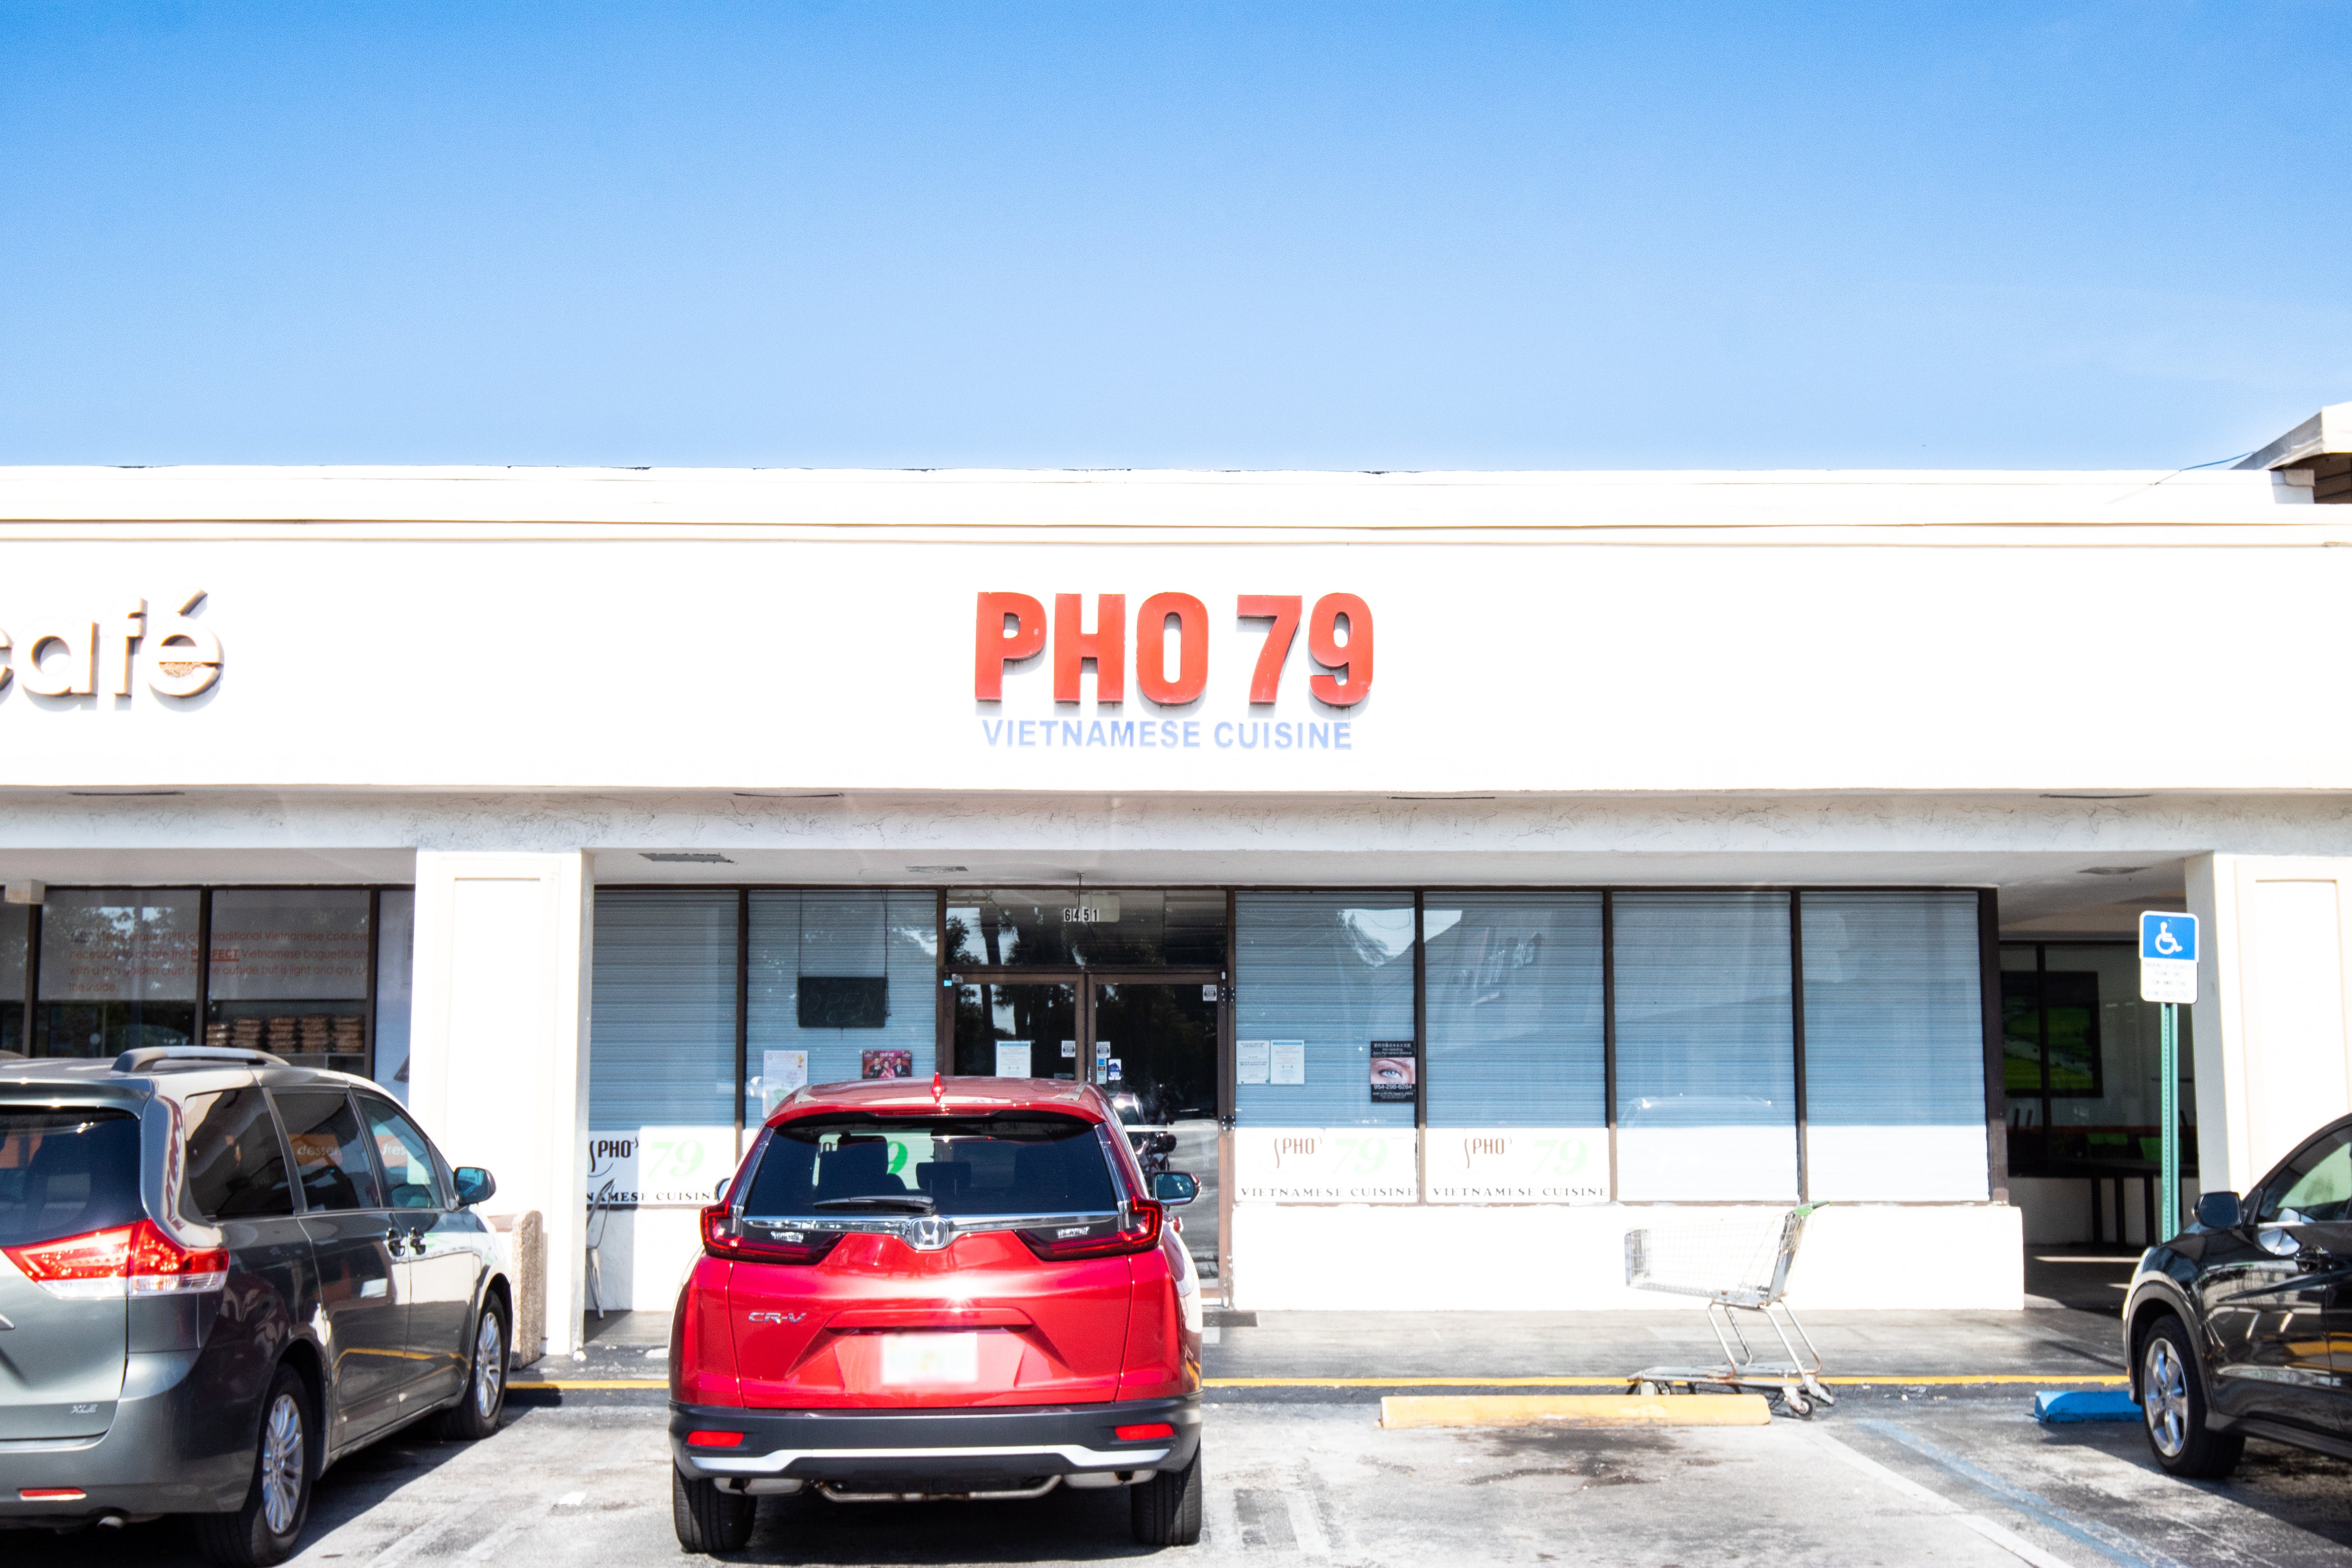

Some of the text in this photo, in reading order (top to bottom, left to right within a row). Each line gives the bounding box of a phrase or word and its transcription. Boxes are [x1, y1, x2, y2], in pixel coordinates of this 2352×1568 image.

[0, 587, 223, 698] afé
[975, 592, 1373, 705] PHO 79
[982, 720, 1352, 750] VIETNAMESE CUISINE
[1065, 909, 1097, 921] 6451
[265, 931, 323, 941] Vietnamese
[241, 949, 301, 959] Vietnamese
[647, 1139, 705, 1179] 79
[1241, 1187, 1416, 1197] VIETNAMESE CUISINE
[1433, 1187, 1608, 1196] VIETNAMESE CUISINE
[748, 1312, 807, 1324] CR-V
[70, 1404, 98, 1414] XLE
